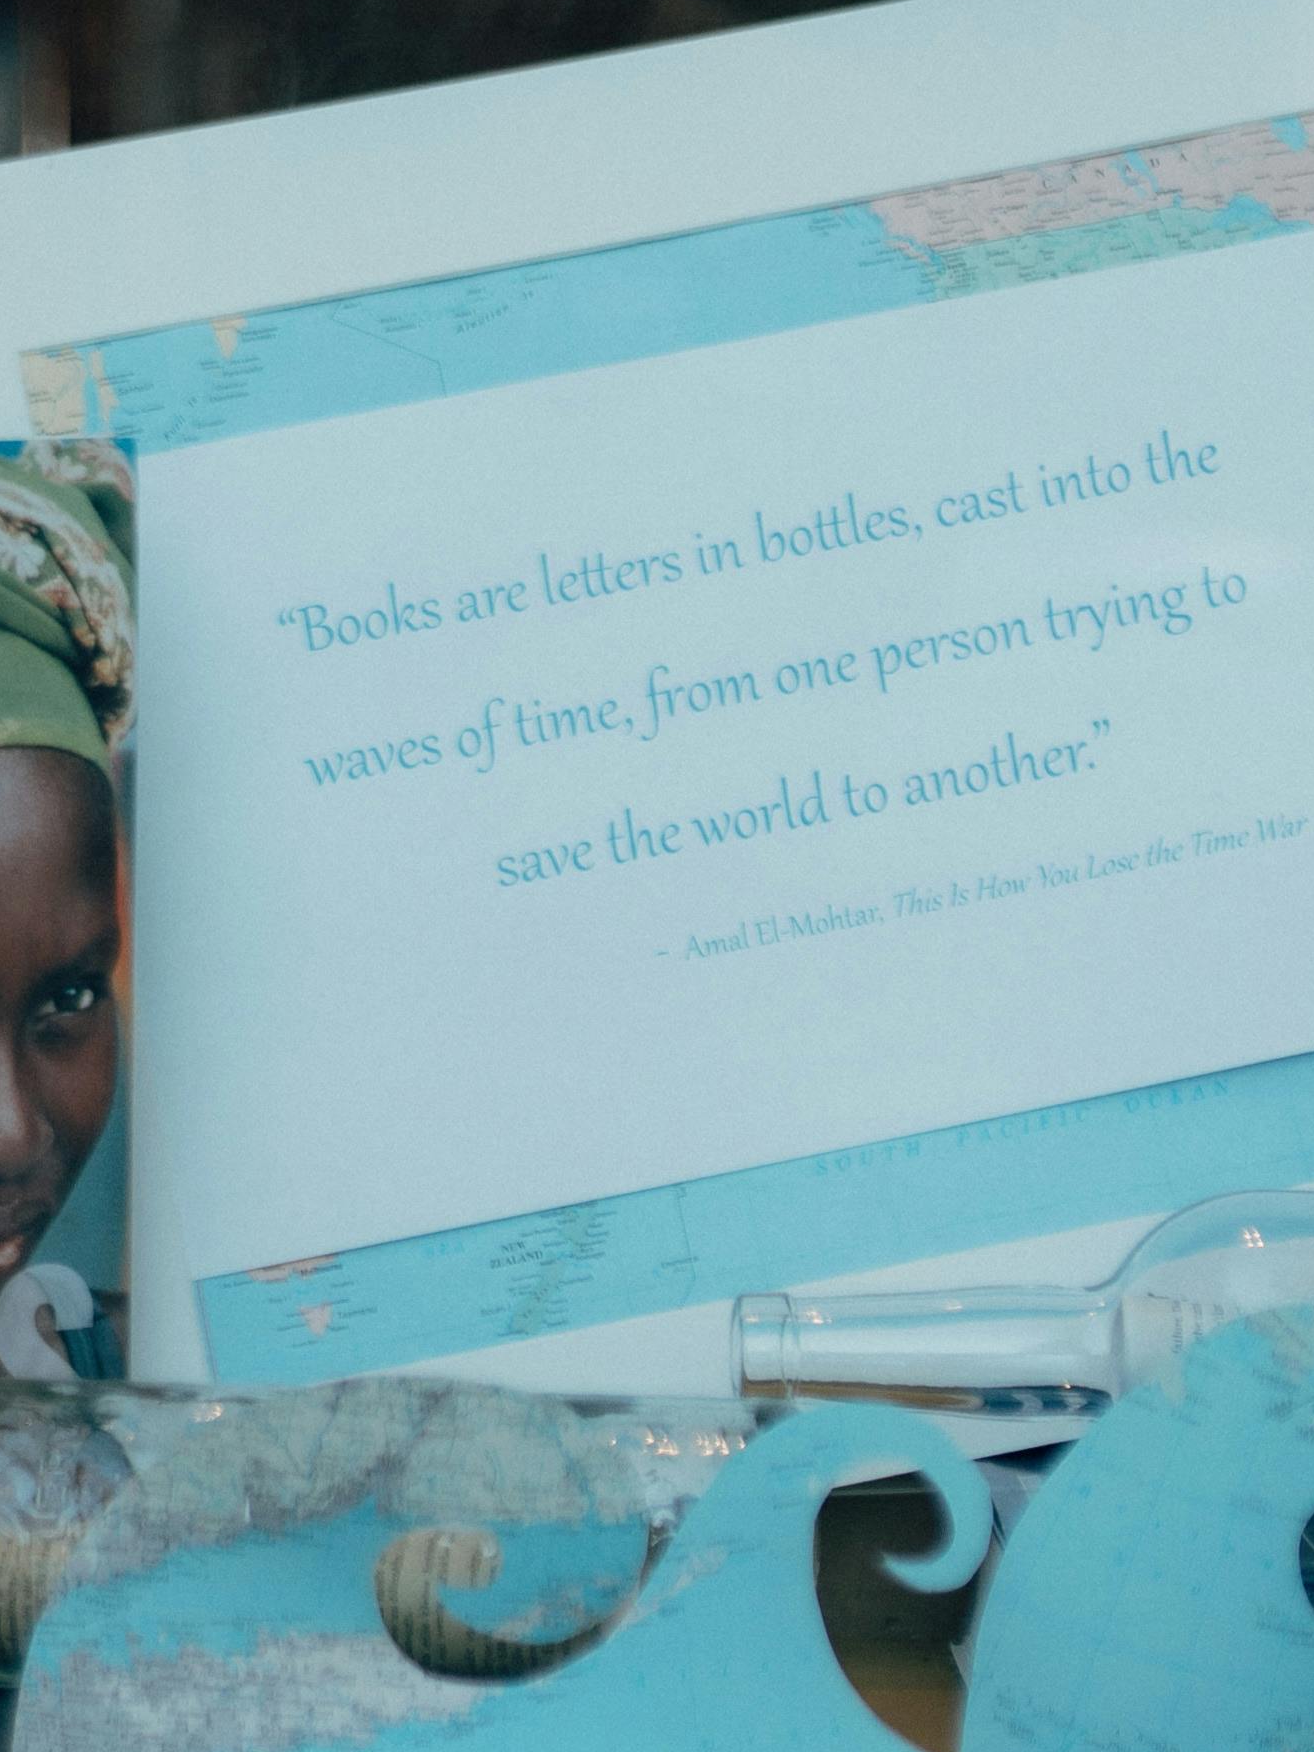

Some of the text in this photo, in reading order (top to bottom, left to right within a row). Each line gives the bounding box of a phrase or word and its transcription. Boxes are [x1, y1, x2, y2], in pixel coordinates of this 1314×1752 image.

[456, 581, 526, 623] are
[539, 552, 683, 605] letters
[695, 532, 744, 575] in
[754, 492, 923, 562] bottles,
[935, 471, 1025, 528] cast
[1039, 455, 1131, 507] into
[1145, 429, 1218, 485] the
[303, 567, 1247, 786] waves of time, from one person trying to
[496, 840, 592, 887] save
[607, 807, 680, 864] the
[690, 780, 830, 846] world
[843, 775, 888, 817] to
[685, 922, 750, 960] Amal
[893, 887, 942, 917] This
[950, 881, 969, 906] Is
[977, 875, 1031, 900] How
[1037, 864, 1079, 888] You
[1086, 853, 1140, 880] Lose
[1145, 837, 1184, 867] the
[1191, 830, 1249, 856] Time
[1256, 815, 1308, 842] War
